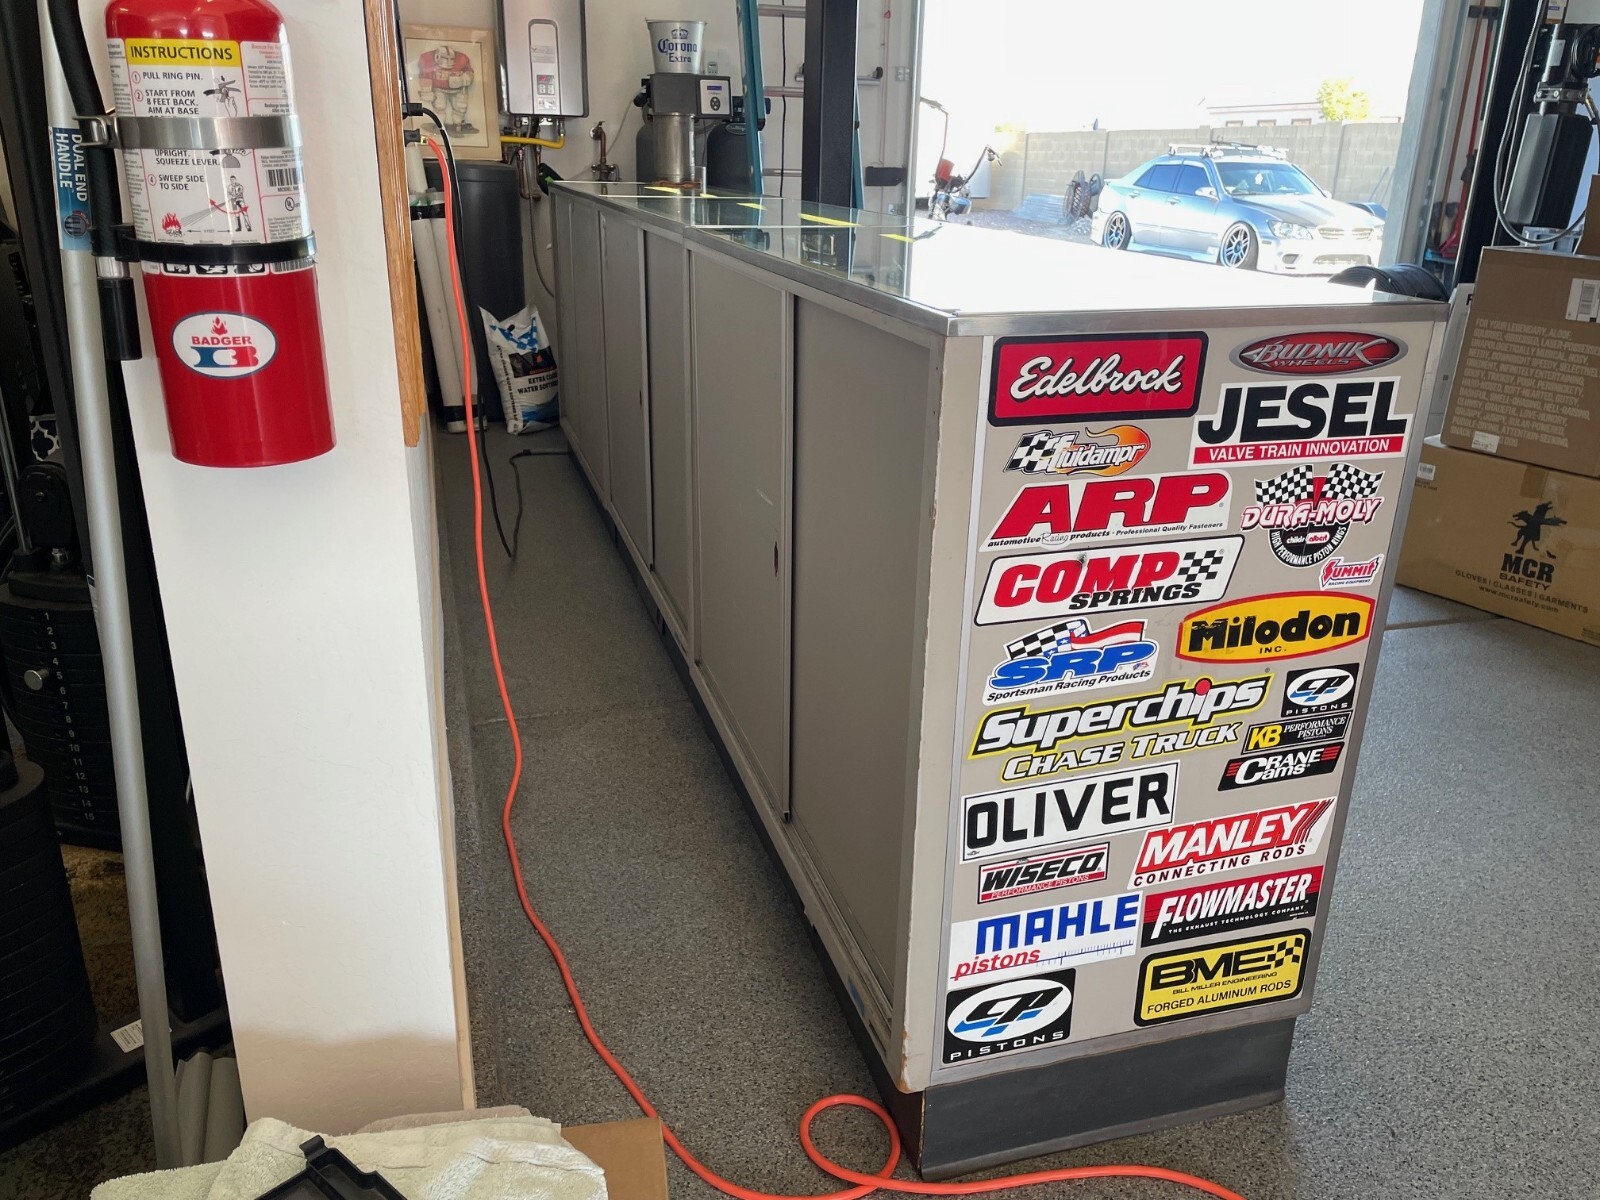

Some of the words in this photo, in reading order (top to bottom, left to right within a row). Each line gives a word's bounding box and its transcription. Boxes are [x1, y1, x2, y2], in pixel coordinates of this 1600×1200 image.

[130, 46, 233, 60] INSTRUCTIONS
[658, 39, 697, 55] Corona
[669, 53, 691, 62] Extra
[56, 133, 73, 188] HANDLE
[71, 134, 85, 171] DUAL
[155, 149, 190, 157] UPRIGHT.
[75, 174, 87, 202] END
[191, 336, 252, 345] BADGER
[1252, 339, 1387, 366] BUDNIK
[1010, 353, 1183, 399] Edelbrock
[1273, 359, 1349, 367] WHEELS
[518, 385, 538, 394] WATER
[1198, 381, 1408, 444] JESEL
[1209, 446, 1253, 461] VALVE
[1260, 443, 1301, 459] TRAIN
[1305, 439, 1390, 456] INNOVATION
[990, 473, 1230, 540] ARP
[1241, 498, 1383, 529] DURA-MOLY
[988, 536, 1041, 547] automotive
[1070, 531, 1110, 541] products
[1116, 527, 1160, 536] Professional
[1162, 524, 1187, 532] Quality
[1188, 522, 1223, 530] Fasteners
[1276, 545, 1312, 565] PERFORMANCE
[1314, 543, 1334, 562] PISTON
[1331, 527, 1347, 546] RINGS
[993, 551, 1180, 608] COMP
[1499, 572, 1551, 591] SAFETY
[1501, 553, 1555, 583] MCR
[1068, 582, 1202, 611] SPRINGS
[1455, 570, 1488, 585] GLOVES
[1493, 581, 1532, 596] GLASSES
[1539, 594, 1589, 614] GARMENTS
[1478, 585, 1559, 613] www.mcrsafety.com
[45, 612, 49, 620] 1
[47, 627, 53, 635] 2
[1188, 610, 1361, 652] Milodon
[1259, 646, 1287, 654] INC.
[990, 643, 1155, 689] SRP
[987, 685, 1053, 702] Sportsman
[1054, 677, 1096, 690] Racing
[1098, 669, 1151, 684] Products
[976, 679, 1264, 752] Superchips
[1286, 702, 1348, 716] PISTONS
[1248, 724, 1283, 750] KB
[1284, 717, 1346, 733] PERFORMANCE
[1297, 726, 1333, 738] PISTONS
[69, 744, 80, 752] 10
[1003, 743, 1125, 781] CHASE
[1132, 723, 1243, 758] TRUCK
[75, 772, 86, 780] 12
[966, 772, 1170, 850] OLIVER
[1137, 804, 1311, 872] MANLEY
[982, 852, 1104, 892] WISECO
[1134, 855, 1251, 887] CONNECTING
[1260, 844, 1306, 862] RODS
[991, 881, 1052, 898] PERFORMANCE
[1055, 874, 1089, 886] PISTONS
[1151, 873, 1313, 939] FLOWMASTER
[1185, 921, 1218, 930] EXHAUST
[1222, 912, 1268, 924] TECHNOLOGY
[1271, 905, 1304, 916] COMPANY
[976, 894, 1140, 955] MAHLE
[954, 949, 1040, 981] pistons
[1150, 945, 1275, 991] BME
[1147, 998, 1194, 1014] FORGED
[1197, 988, 1257, 1005] ALUMINUM
[1260, 980, 1291, 992] RODS
[1190, 982, 1220, 992] MILLER
[1222, 972, 1278, 985] ENGINEERING
[950, 1030, 1064, 1060] PISTONS
